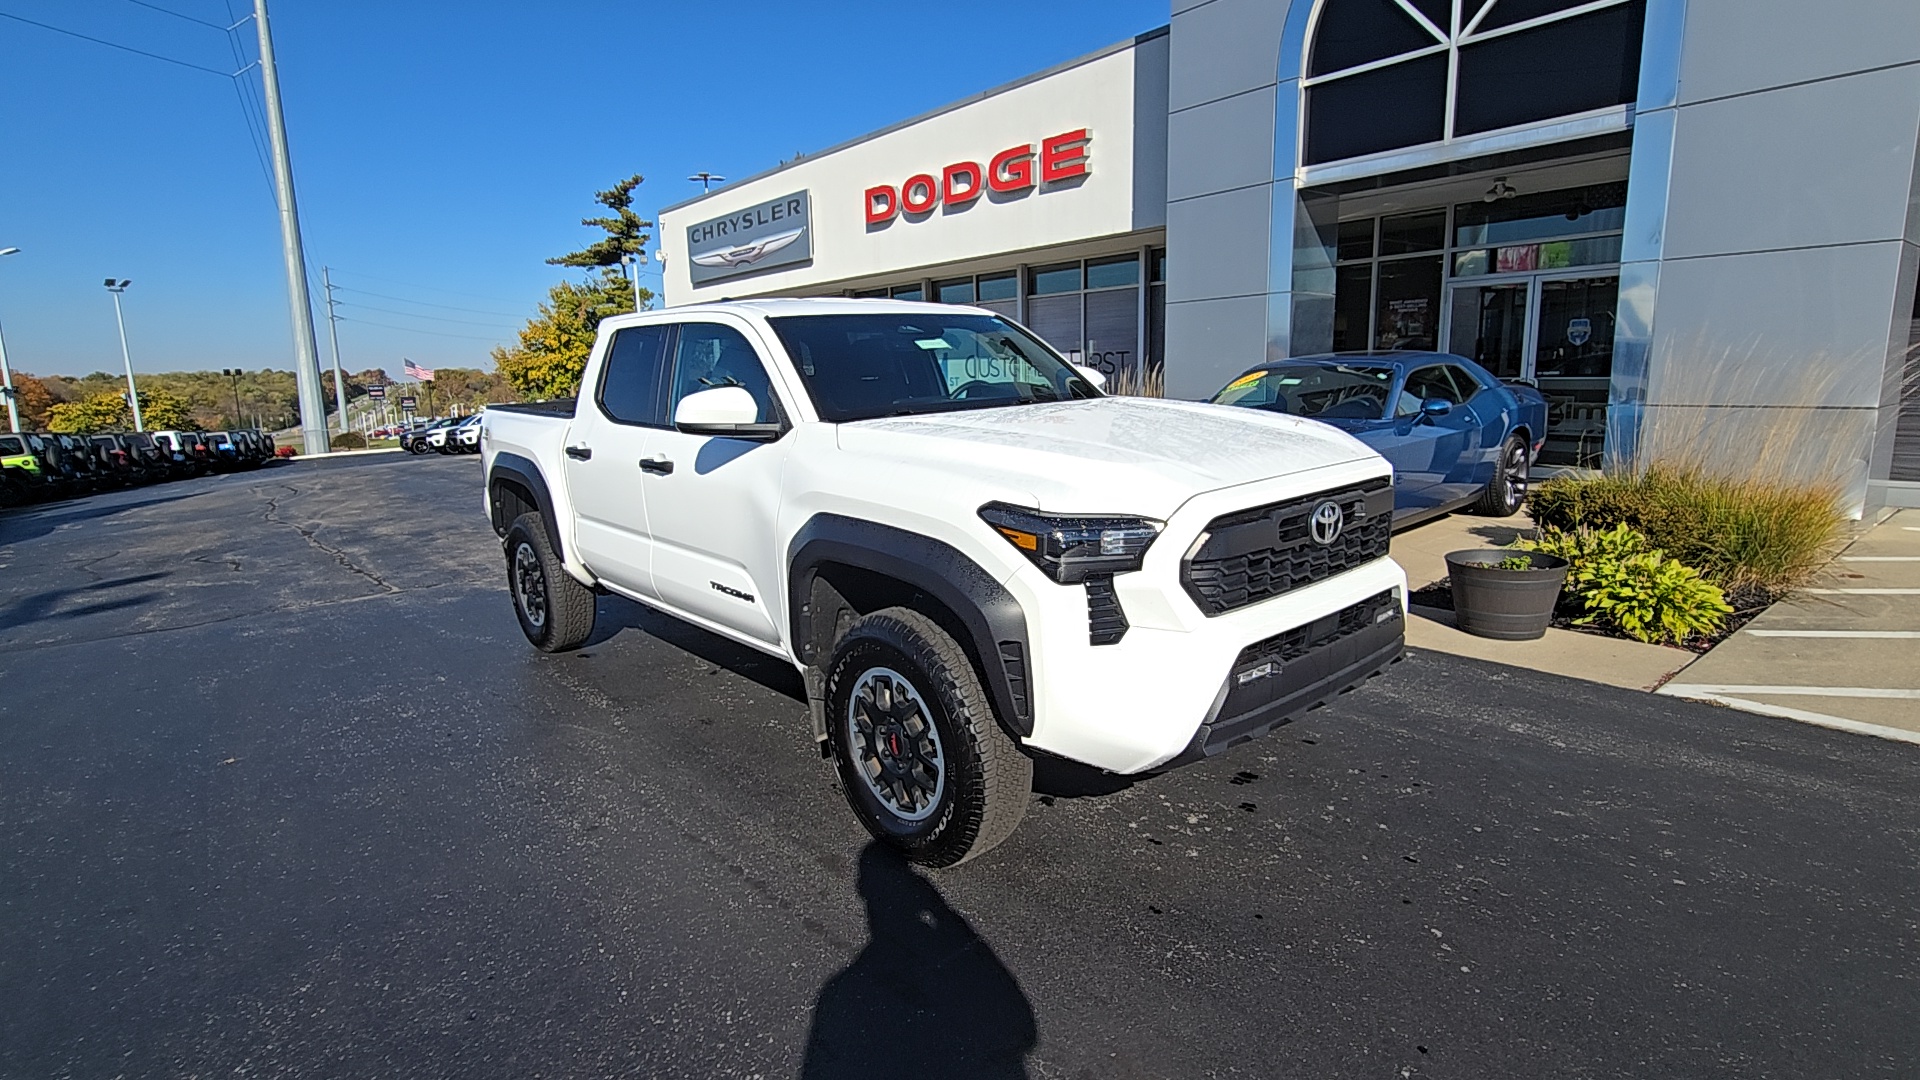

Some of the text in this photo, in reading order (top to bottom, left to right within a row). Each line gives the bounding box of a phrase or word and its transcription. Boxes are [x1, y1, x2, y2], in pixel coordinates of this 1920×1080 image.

[865, 128, 1090, 224] DODGE
[691, 199, 801, 244] CHRYSLER
[1070, 349, 1131, 375] FRST
[709, 580, 756, 604] TACOMA
